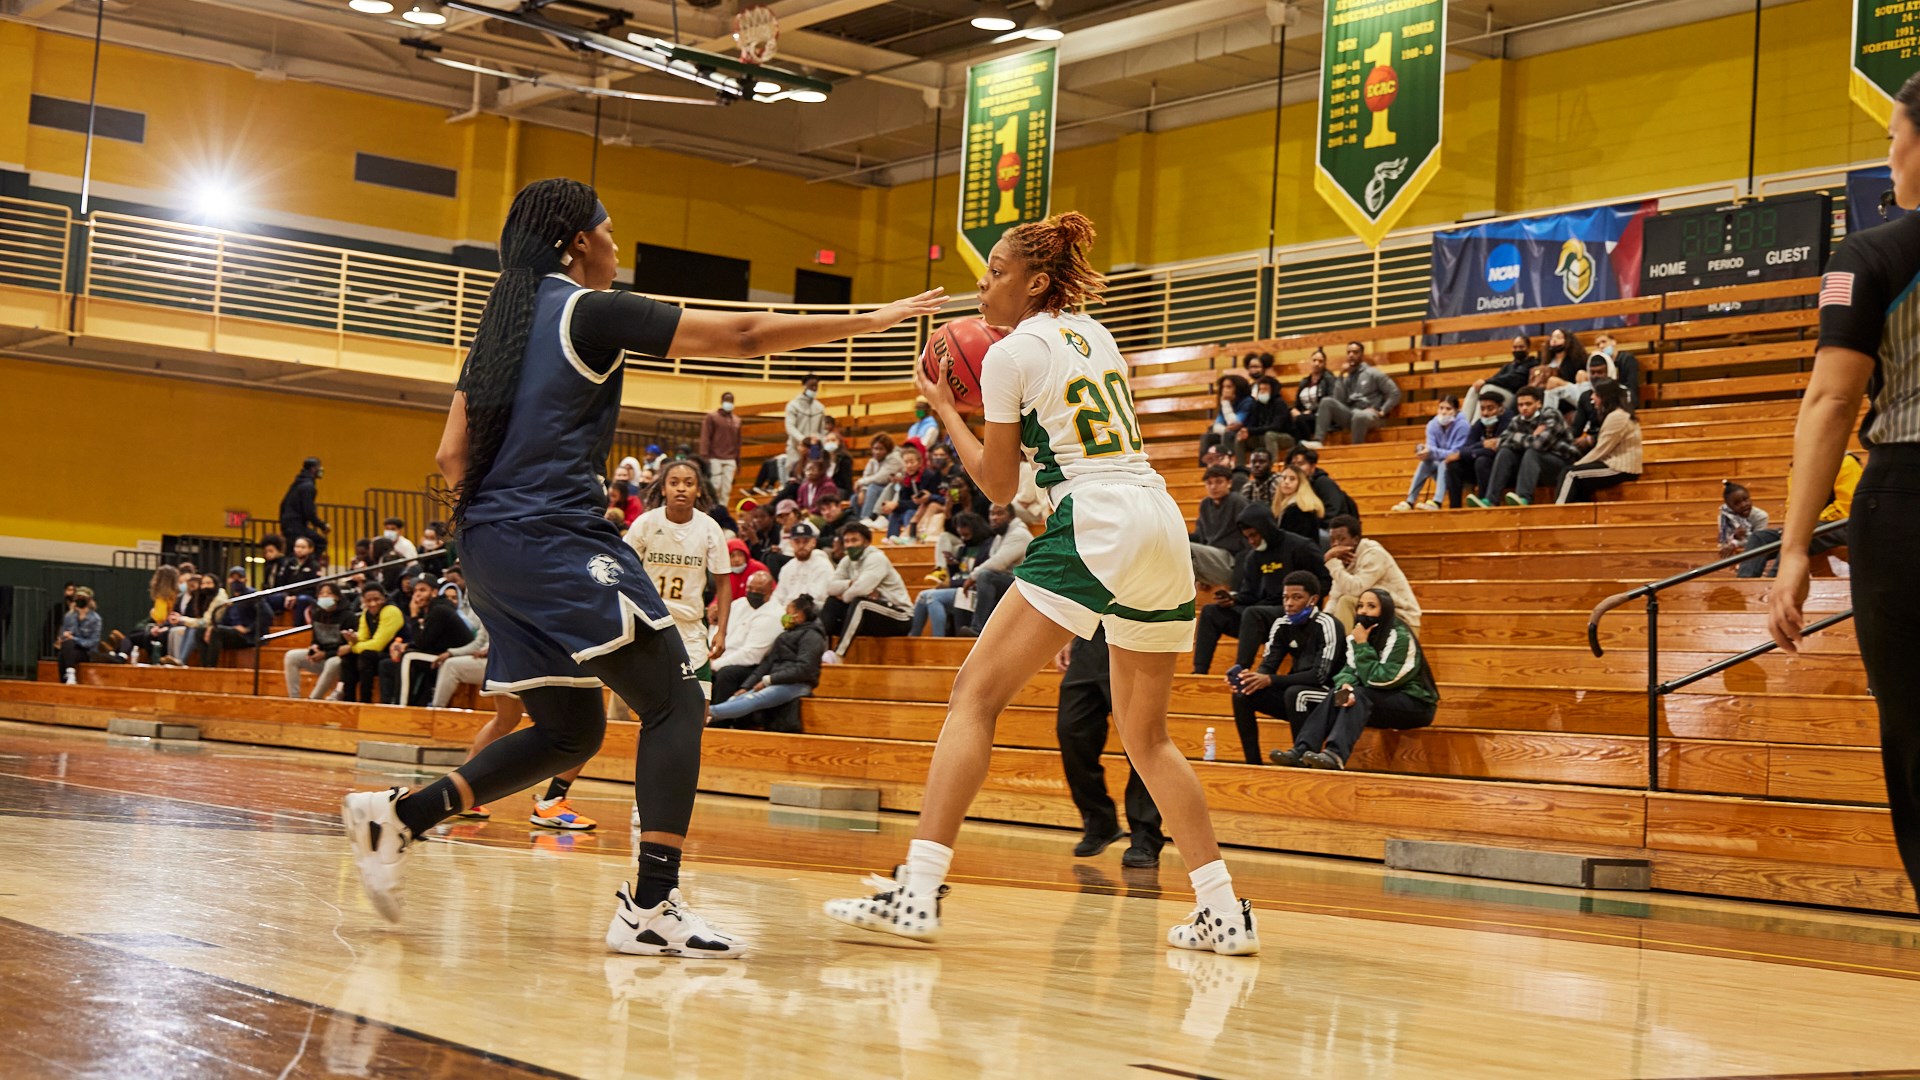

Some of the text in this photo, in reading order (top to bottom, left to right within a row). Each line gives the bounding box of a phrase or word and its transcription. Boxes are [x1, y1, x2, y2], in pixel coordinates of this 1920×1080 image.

[1875, 3, 1904, 17] SOUTH
[1402, 20, 1434, 38] WOMEN
[1862, 36, 1917, 54] NORTHEAST
[1708, 257, 1744, 271] PERIOD
[1766, 246, 1811, 265] GUEST
[1488, 264, 1520, 282] NCAA
[1650, 261, 1687, 278] HOME
[1477, 295, 1514, 310] Division
[1064, 370, 1143, 458] 20
[648, 552, 703, 567] JERSEY CITY
[659, 575, 684, 600] 12
